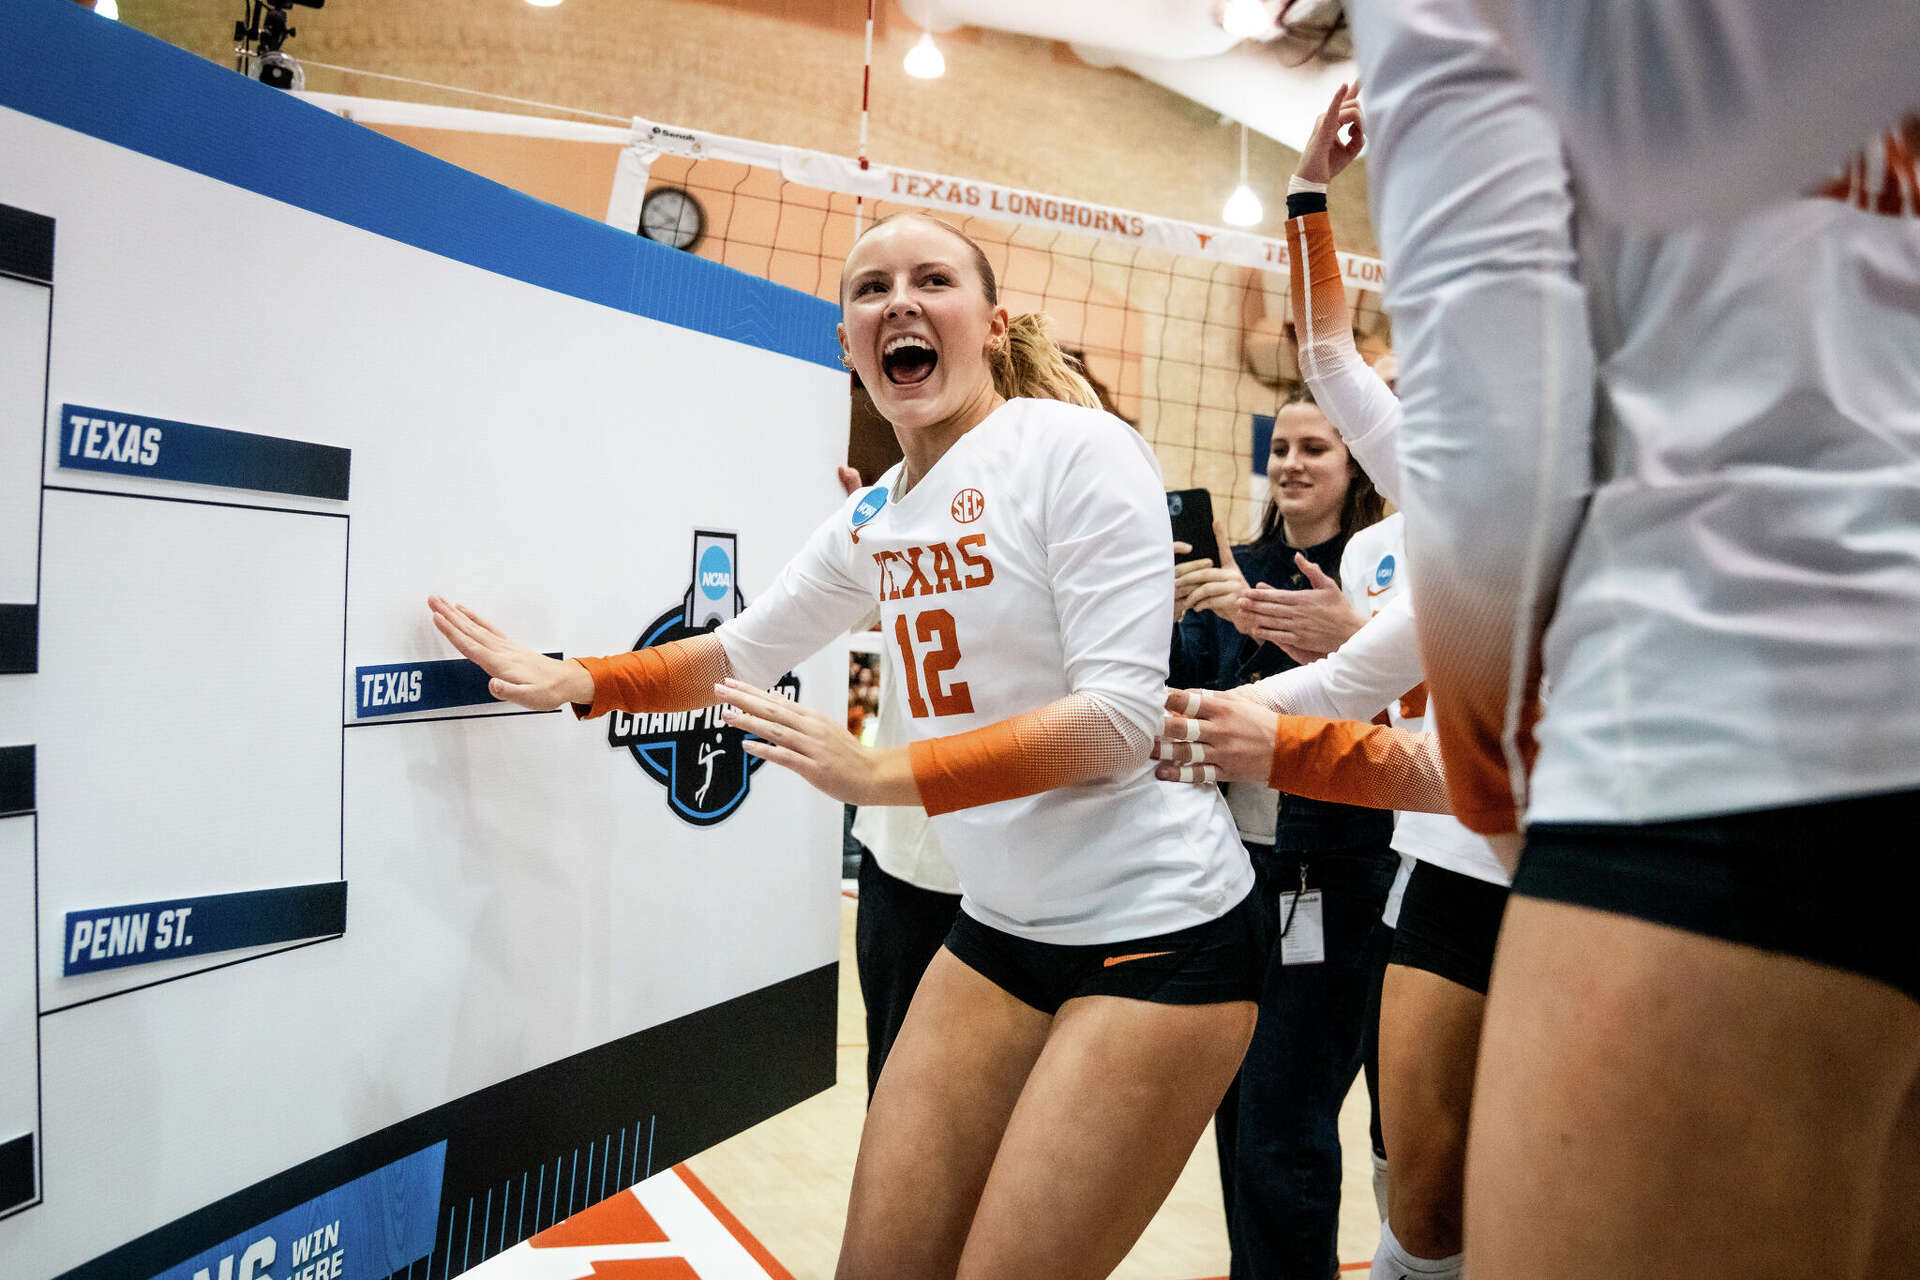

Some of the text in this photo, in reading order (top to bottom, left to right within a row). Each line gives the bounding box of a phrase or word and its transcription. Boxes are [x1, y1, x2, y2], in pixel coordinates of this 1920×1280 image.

[888, 171, 1145, 237] TEXAS LONGHORNS
[69, 415, 162, 466] TEXAS
[952, 489, 985, 523] SEC
[702, 571, 730, 587] NCAA
[895, 609, 975, 718] 12
[361, 670, 423, 707] TEXAS
[69, 907, 193, 963] PENN ST.
[286, 1249, 345, 1280] ERE
[292, 1220, 340, 1268] WIN
